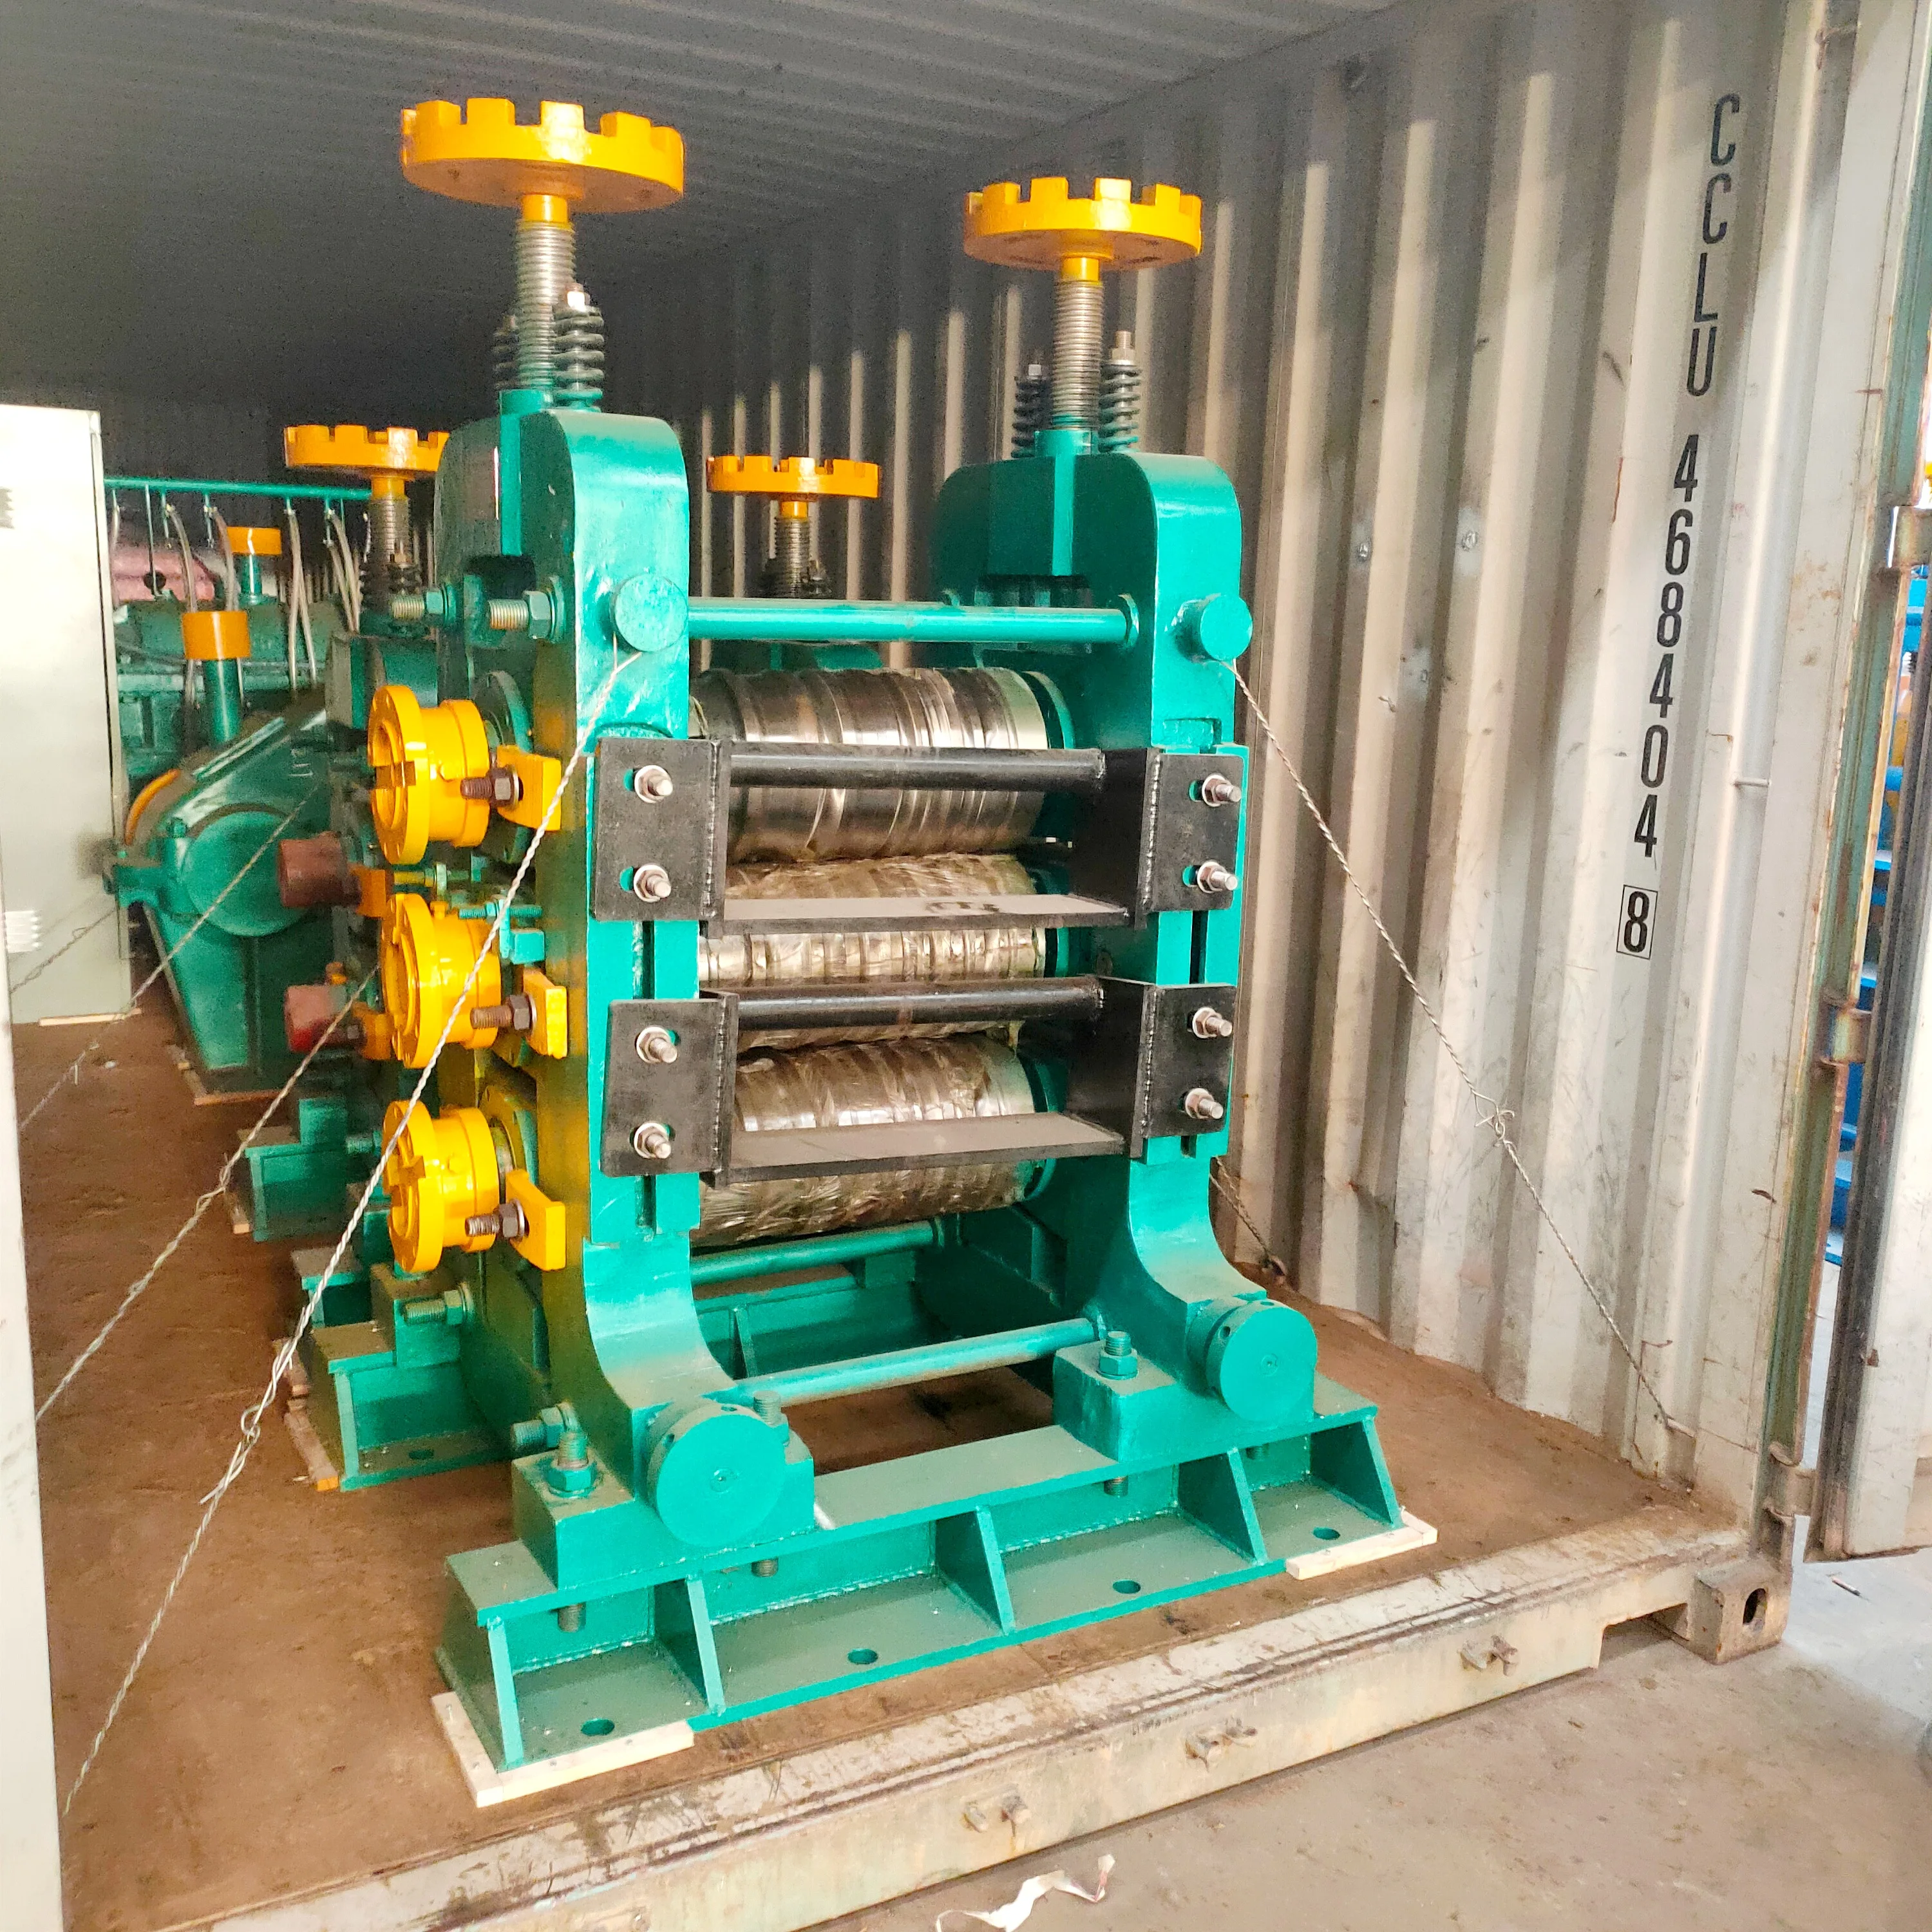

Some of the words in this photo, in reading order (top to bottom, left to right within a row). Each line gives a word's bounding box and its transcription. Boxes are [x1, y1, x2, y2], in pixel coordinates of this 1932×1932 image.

[1687, 93, 1740, 397] CCLU
[1634, 434, 1699, 858] 468404
[1623, 891, 1650, 954] 8
